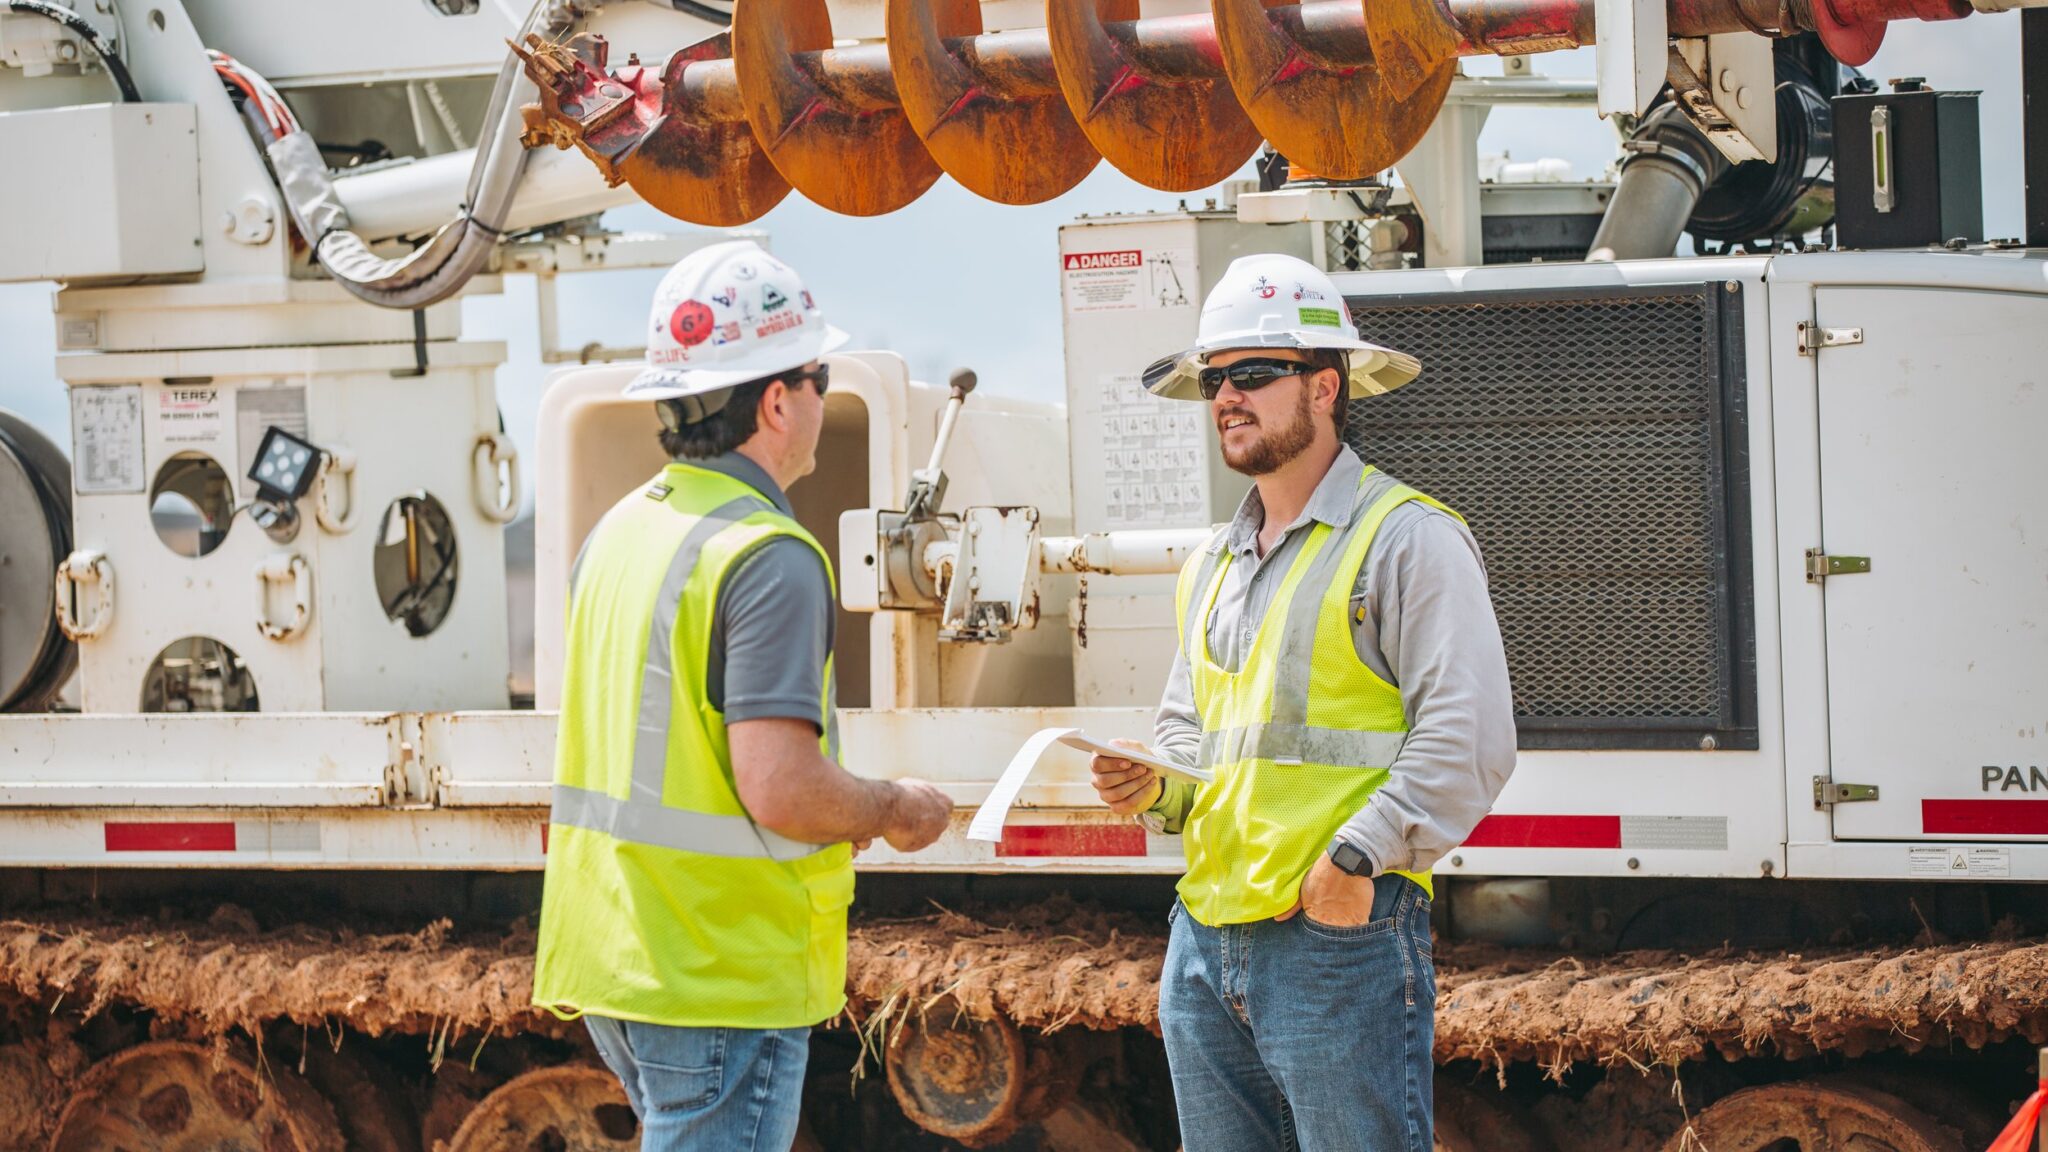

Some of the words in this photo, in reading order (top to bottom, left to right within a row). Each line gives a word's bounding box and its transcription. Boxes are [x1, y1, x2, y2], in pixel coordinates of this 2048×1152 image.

[1080, 253, 1138, 268] DANGER
[173, 388, 218, 404] TEREX
[1981, 766, 2048, 792] PAN
